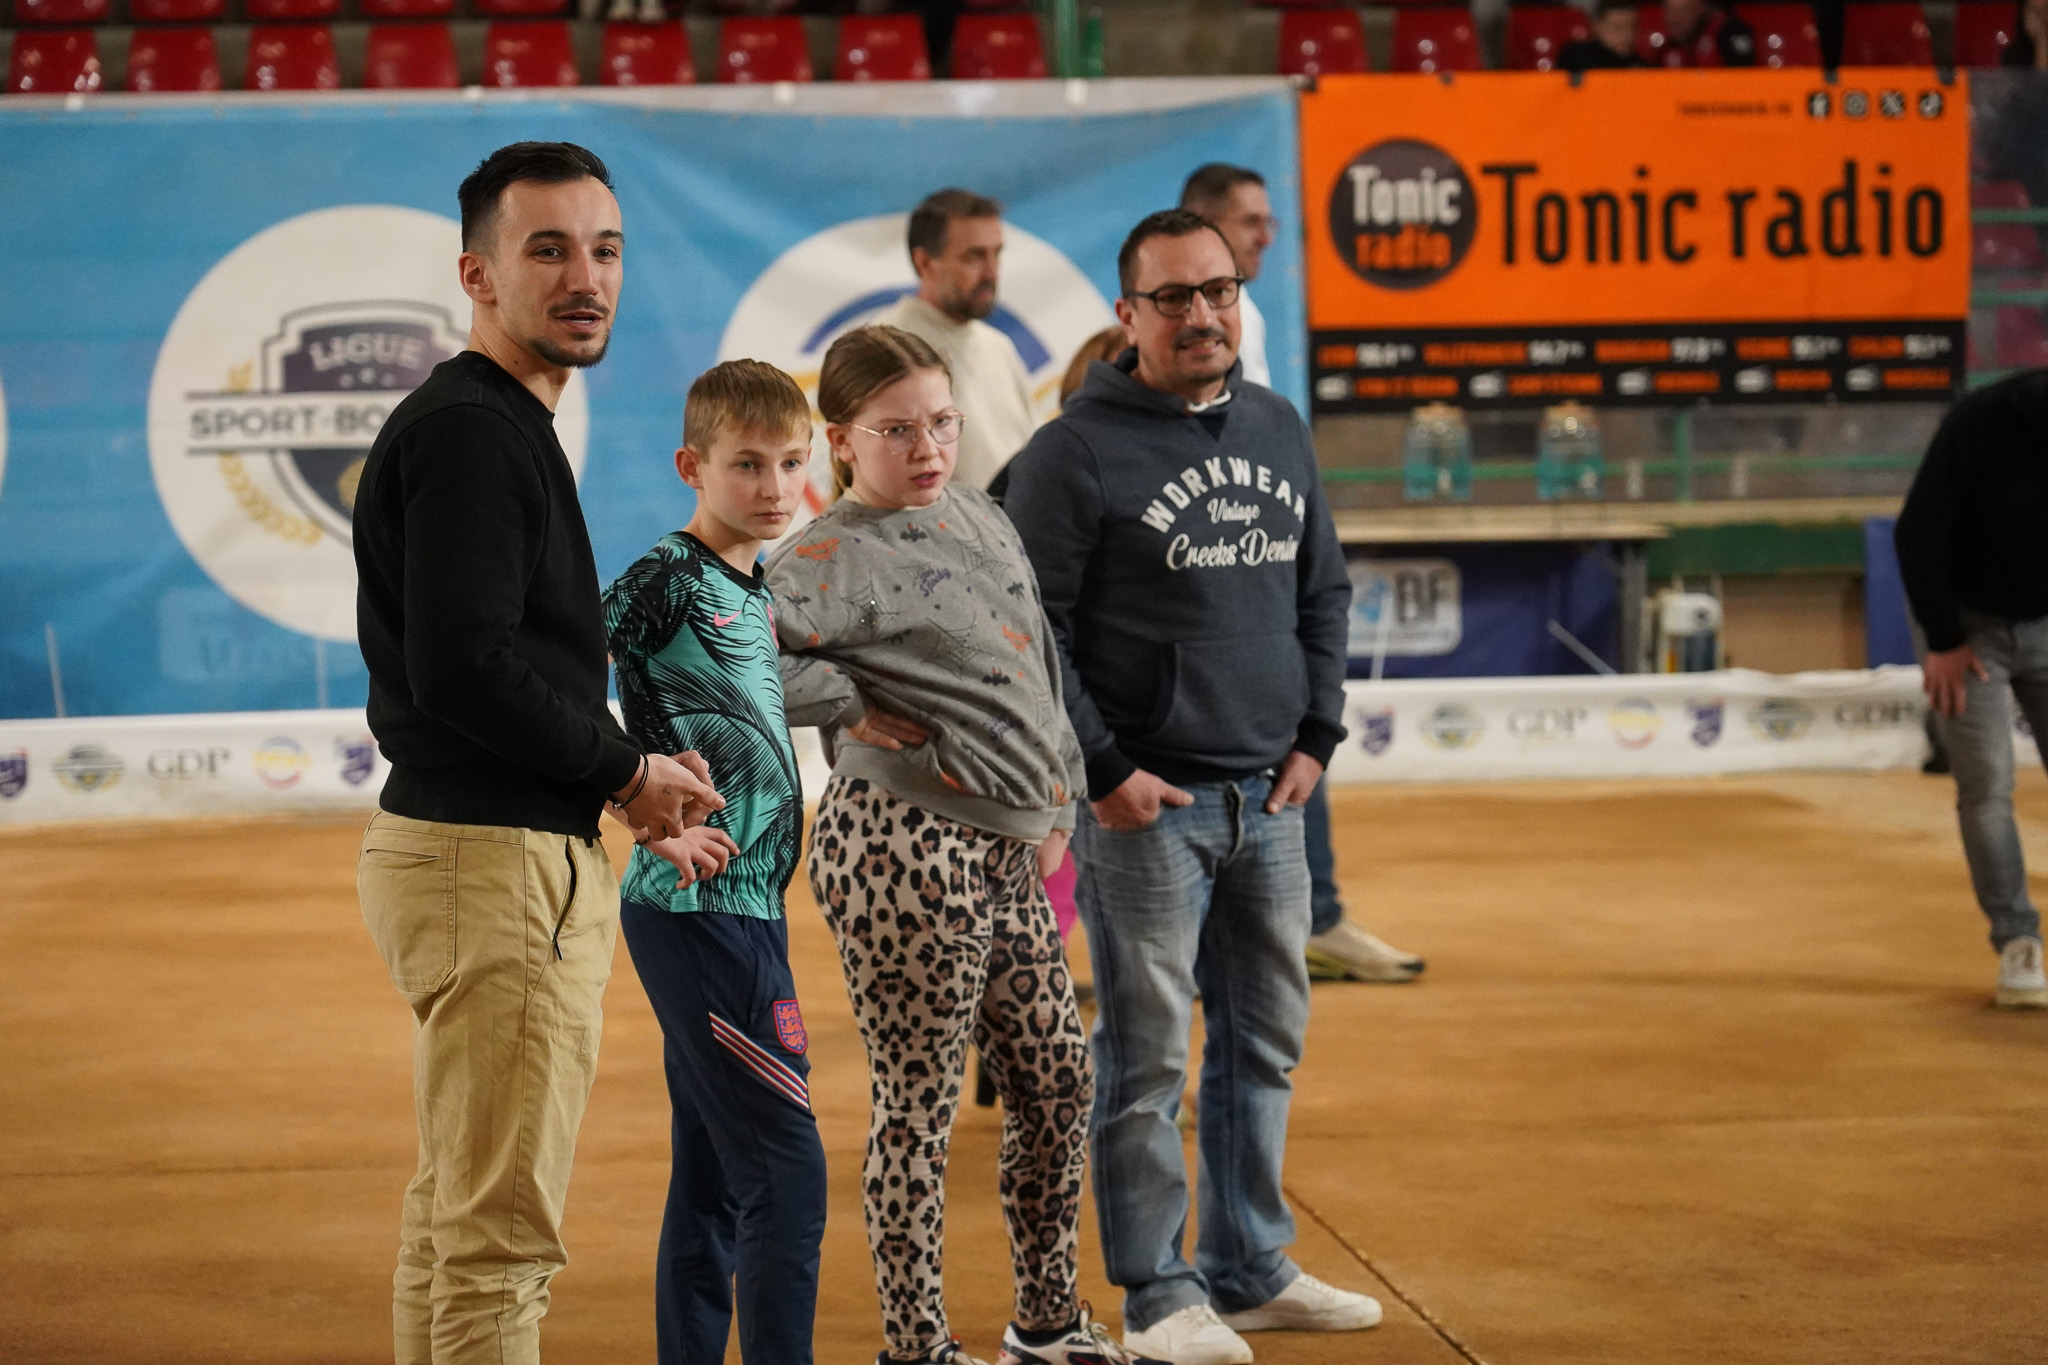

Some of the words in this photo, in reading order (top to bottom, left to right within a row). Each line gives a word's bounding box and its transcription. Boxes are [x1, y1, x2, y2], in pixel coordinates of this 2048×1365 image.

[1348, 163, 1462, 226] Tonic
[1481, 160, 1699, 266] Tonic
[1726, 157, 1944, 259] radio
[1355, 223, 1452, 270] radio
[308, 330, 428, 373] LIGUE
[1206, 496, 1261, 527] Vintage
[1166, 532, 1239, 571] Creeks
